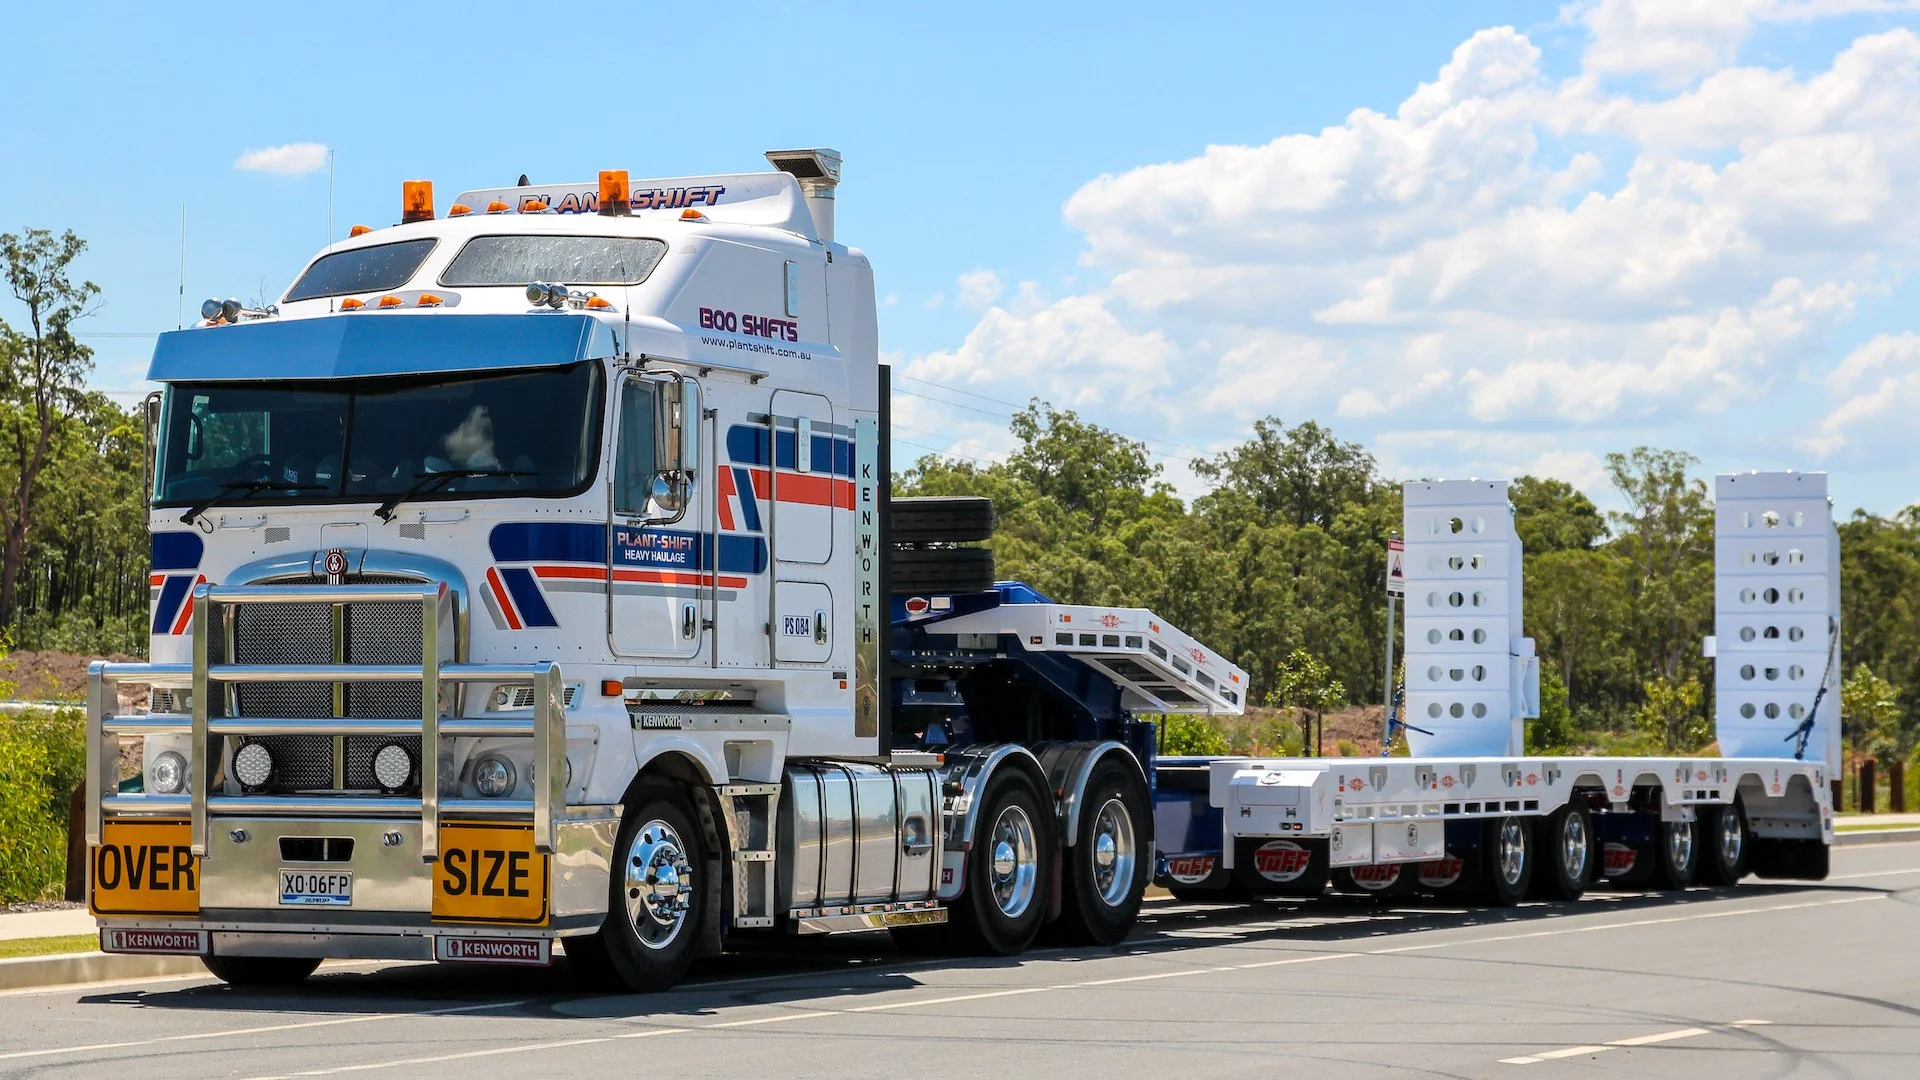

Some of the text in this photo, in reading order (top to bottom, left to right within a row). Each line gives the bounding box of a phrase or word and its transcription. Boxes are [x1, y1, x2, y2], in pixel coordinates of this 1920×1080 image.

[741, 313, 798, 343] SHIFTS
[701, 336, 811, 360] www.plantshift.com.au
[617, 531, 694, 551] PLANT-SHIFT
[624, 549, 686, 564] HEAVY HAULAGE
[861, 463, 872, 643] KENWORTH
[785, 617, 794, 635] PS
[643, 715, 681, 728] KENWORTH
[98, 844, 196, 891] OVER
[442, 847, 530, 898] SIZE
[127, 934, 197, 948] KENWORTH
[464, 943, 538, 957] KENWORTH
